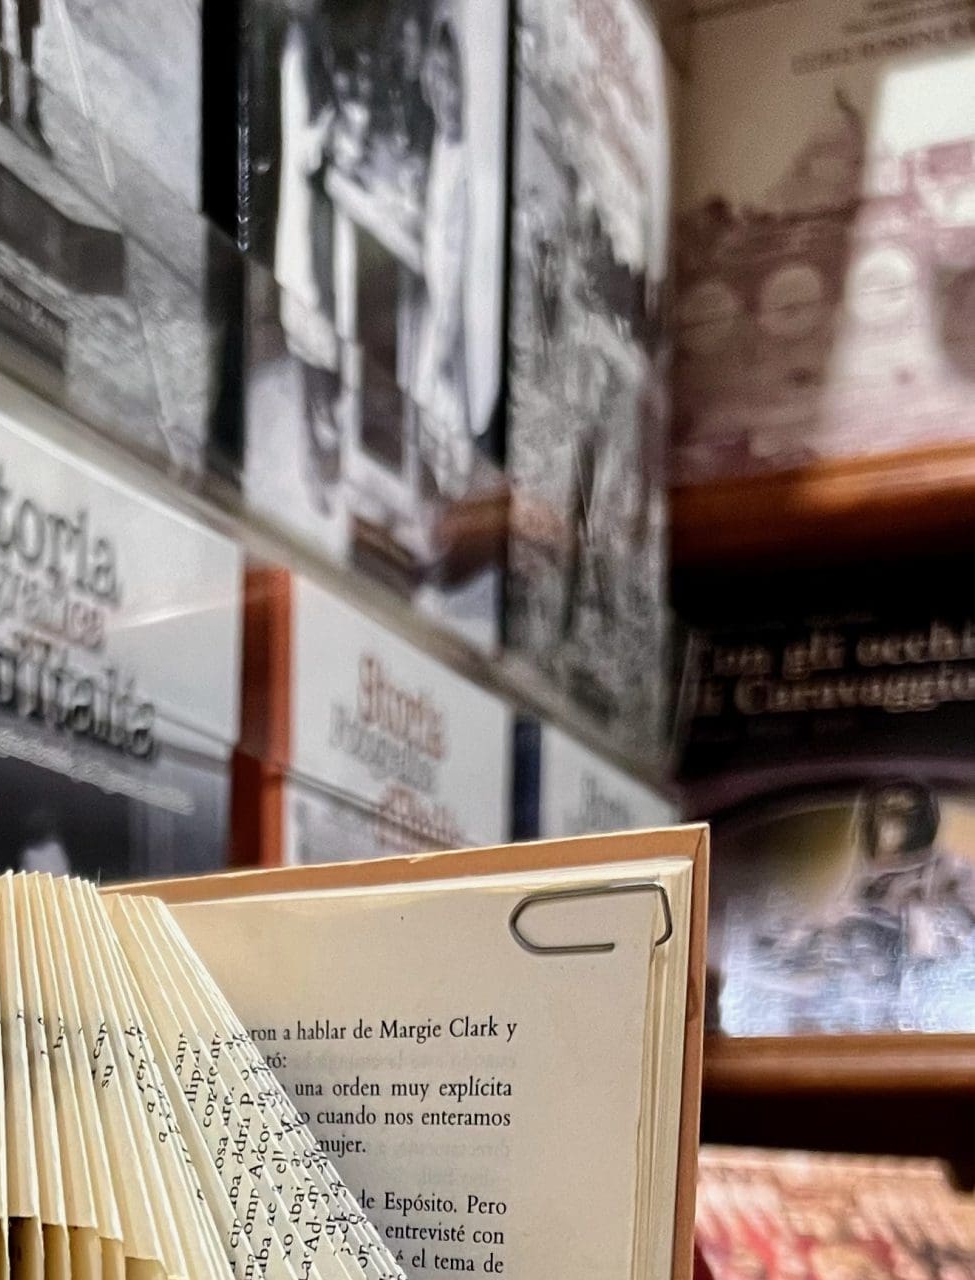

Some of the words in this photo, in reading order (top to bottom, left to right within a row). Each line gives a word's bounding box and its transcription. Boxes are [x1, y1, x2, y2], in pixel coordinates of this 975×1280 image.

[282, 1027, 292, 1041] a
[296, 1019, 347, 1042] hablar
[352, 1016, 374, 1040] de
[378, 1017, 442, 1044] Margie
[448, 1014, 499, 1038] Clark
[505, 1020, 518, 1043] y
[294, 1080, 324, 1097] una
[332, 1075, 381, 1097] orden
[390, 1081, 430, 1103] muy
[438, 1074, 513, 1103] explícita
[316, 1103, 377, 1126] cuando
[383, 1107, 414, 1126] nos
[420, 1107, 512, 1127] enteramos
[384, 1190, 458, 1217] Espósito.
[466, 1194, 508, 1216] Pero
[385, 1221, 466, 1242] entrevisté
[472, 1229, 506, 1245] con
[411, 1248, 427, 1269] el
[433, 1254, 476, 1272] tema
[483, 1252, 505, 1274] de
